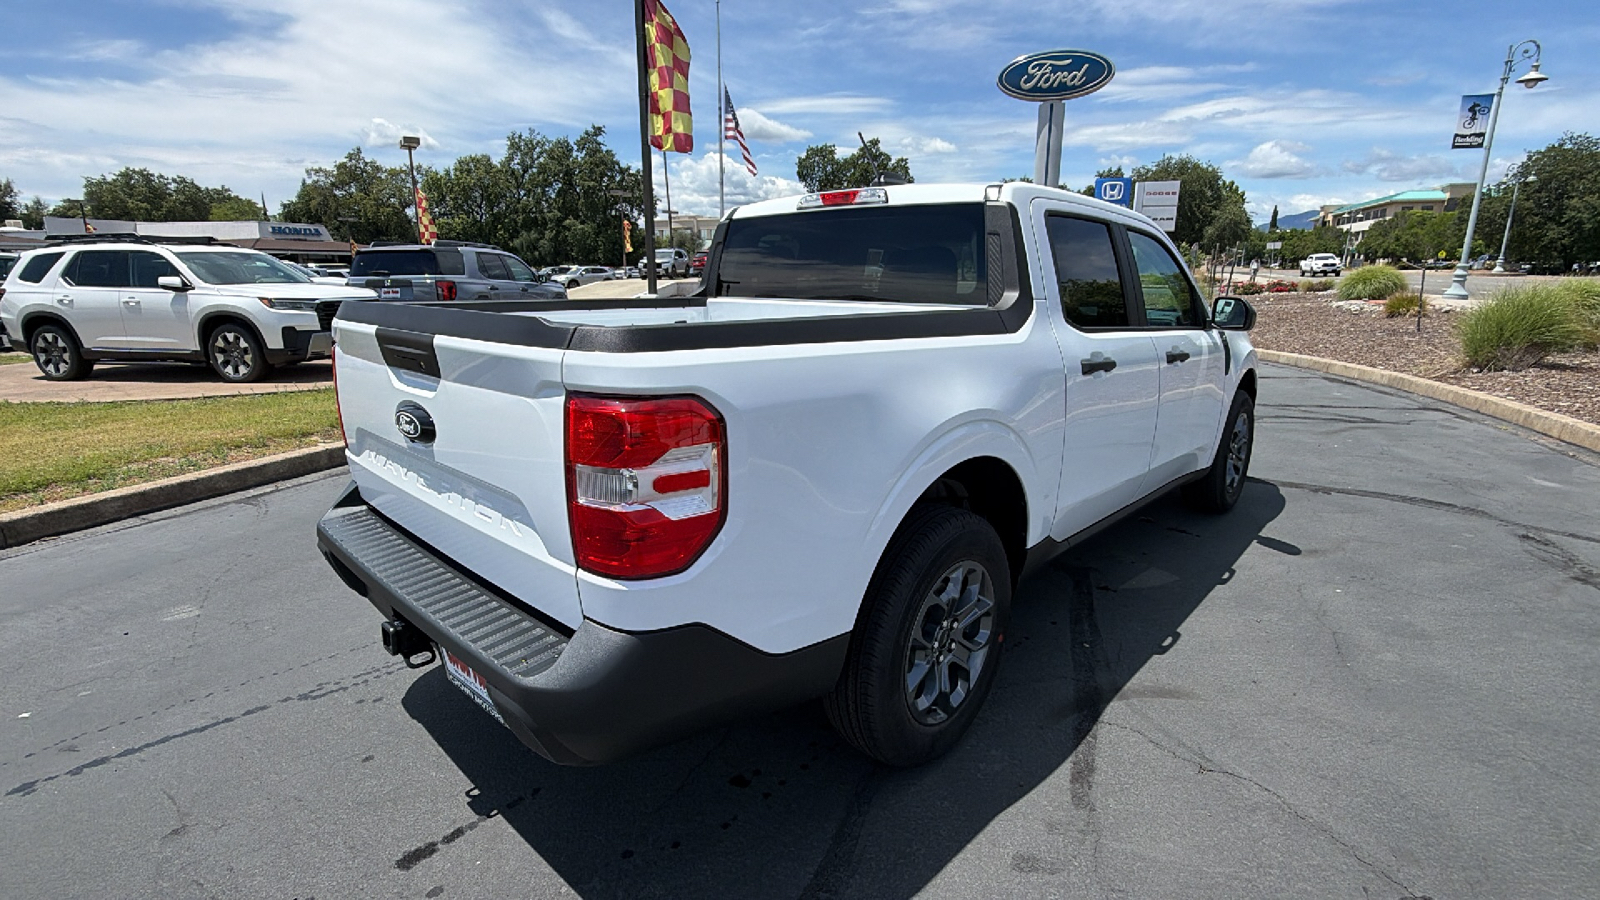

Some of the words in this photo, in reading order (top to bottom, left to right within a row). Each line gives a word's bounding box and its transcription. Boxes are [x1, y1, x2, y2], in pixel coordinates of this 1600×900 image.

[1020, 59, 1089, 90] Ford
[269, 225, 323, 236] HONDA
[399, 414, 416, 434] Ford
